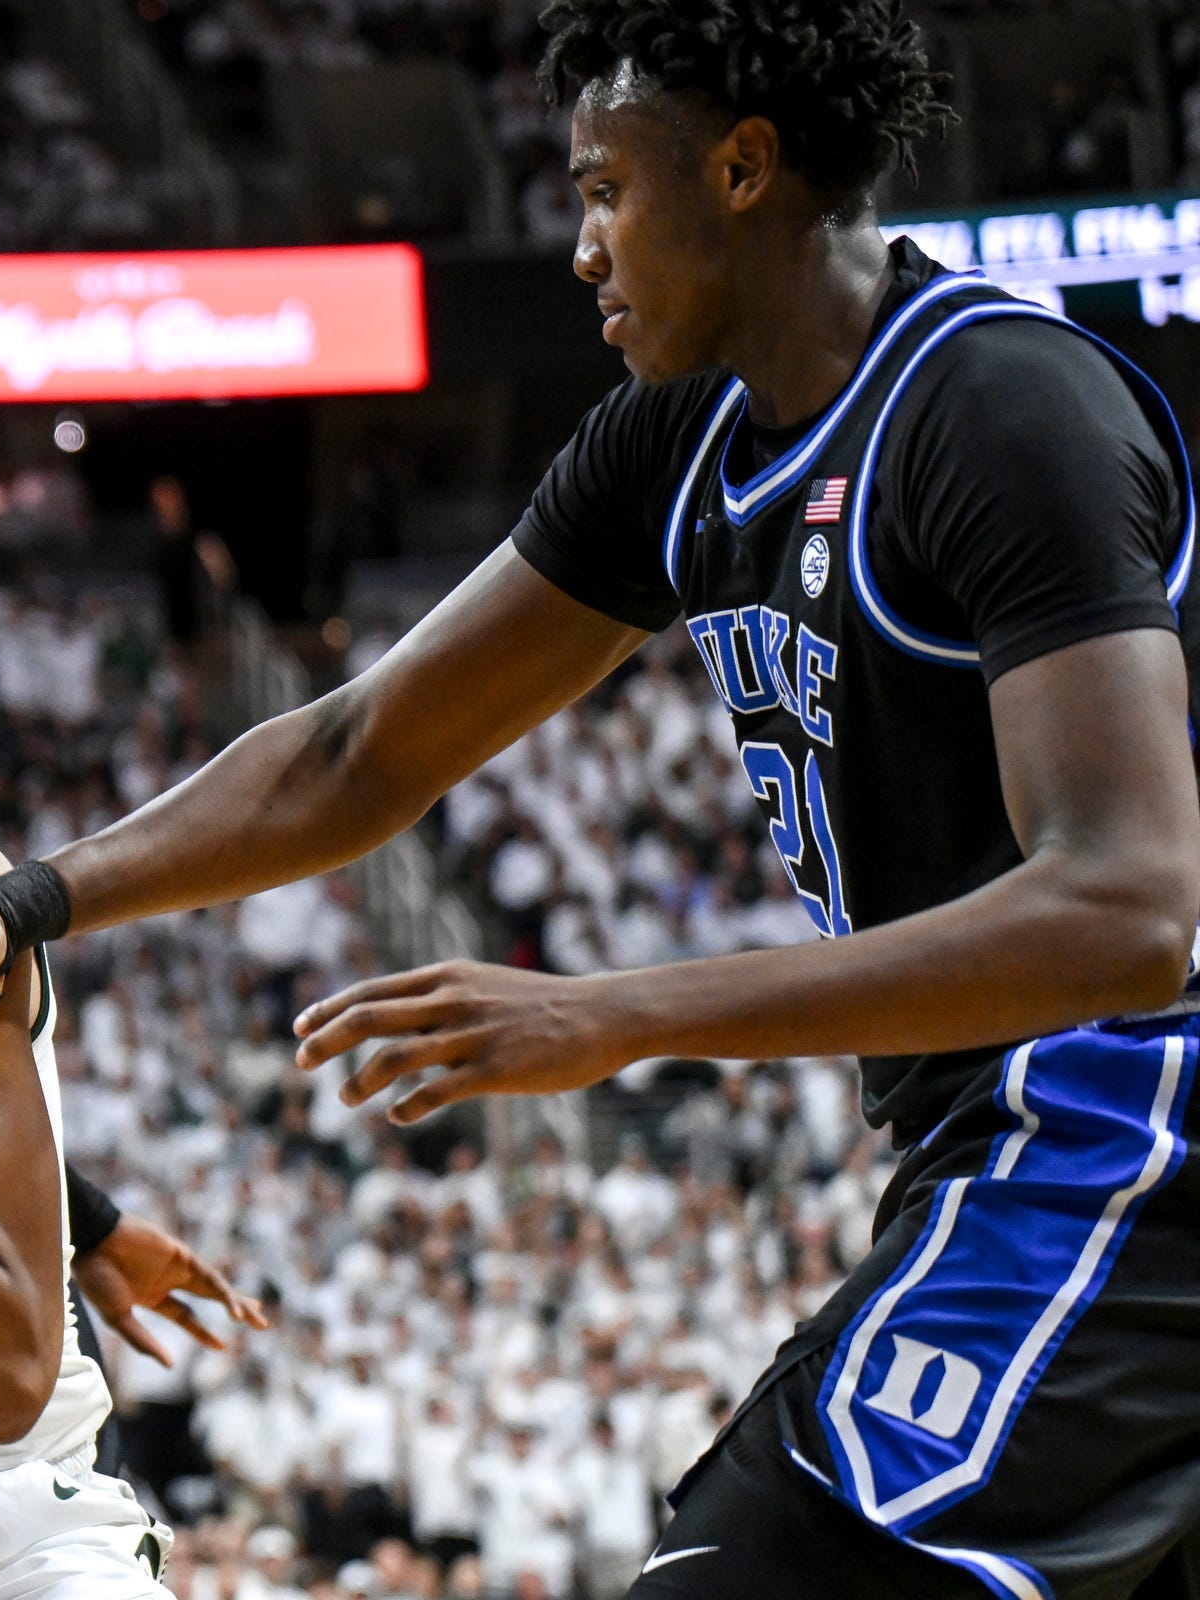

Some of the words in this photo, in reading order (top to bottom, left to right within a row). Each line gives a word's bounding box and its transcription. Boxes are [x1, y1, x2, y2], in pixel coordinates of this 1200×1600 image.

[806, 557, 827, 570] ACC
[740, 741, 852, 938] 21
[864, 1333, 982, 1439] D
